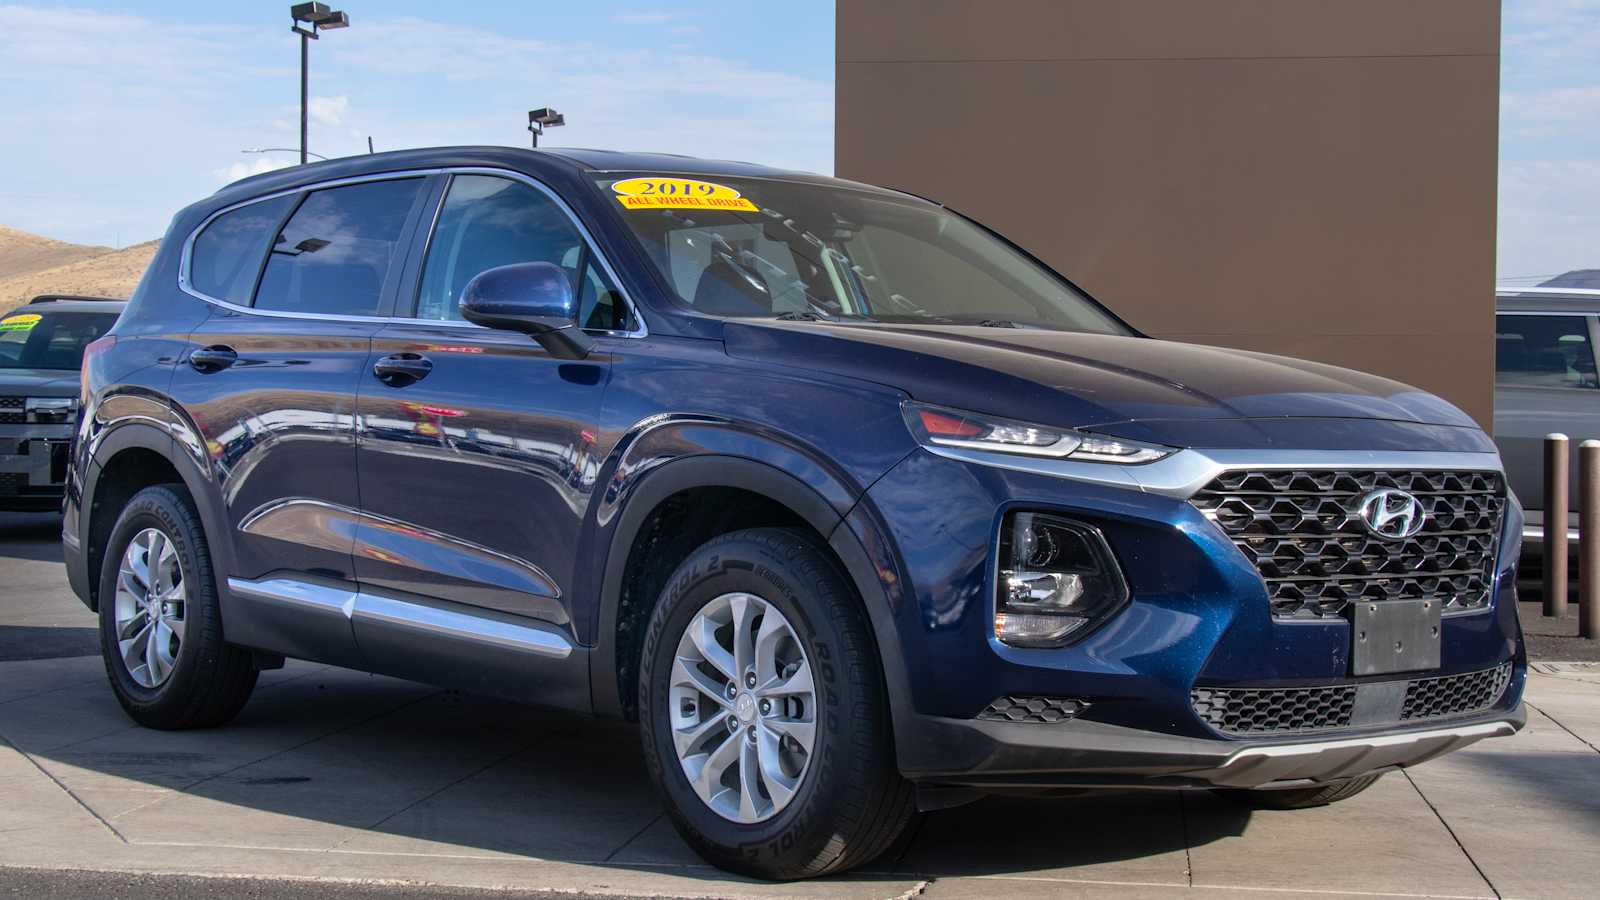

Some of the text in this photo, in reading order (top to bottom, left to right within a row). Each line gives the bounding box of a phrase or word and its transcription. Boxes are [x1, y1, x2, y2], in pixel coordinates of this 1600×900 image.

[627, 197, 747, 208] ALL WHEEL DRIVE
[639, 183, 714, 195] 2019
[643, 565, 698, 673] CONTROL
[815, 642, 838, 735] ROAD
